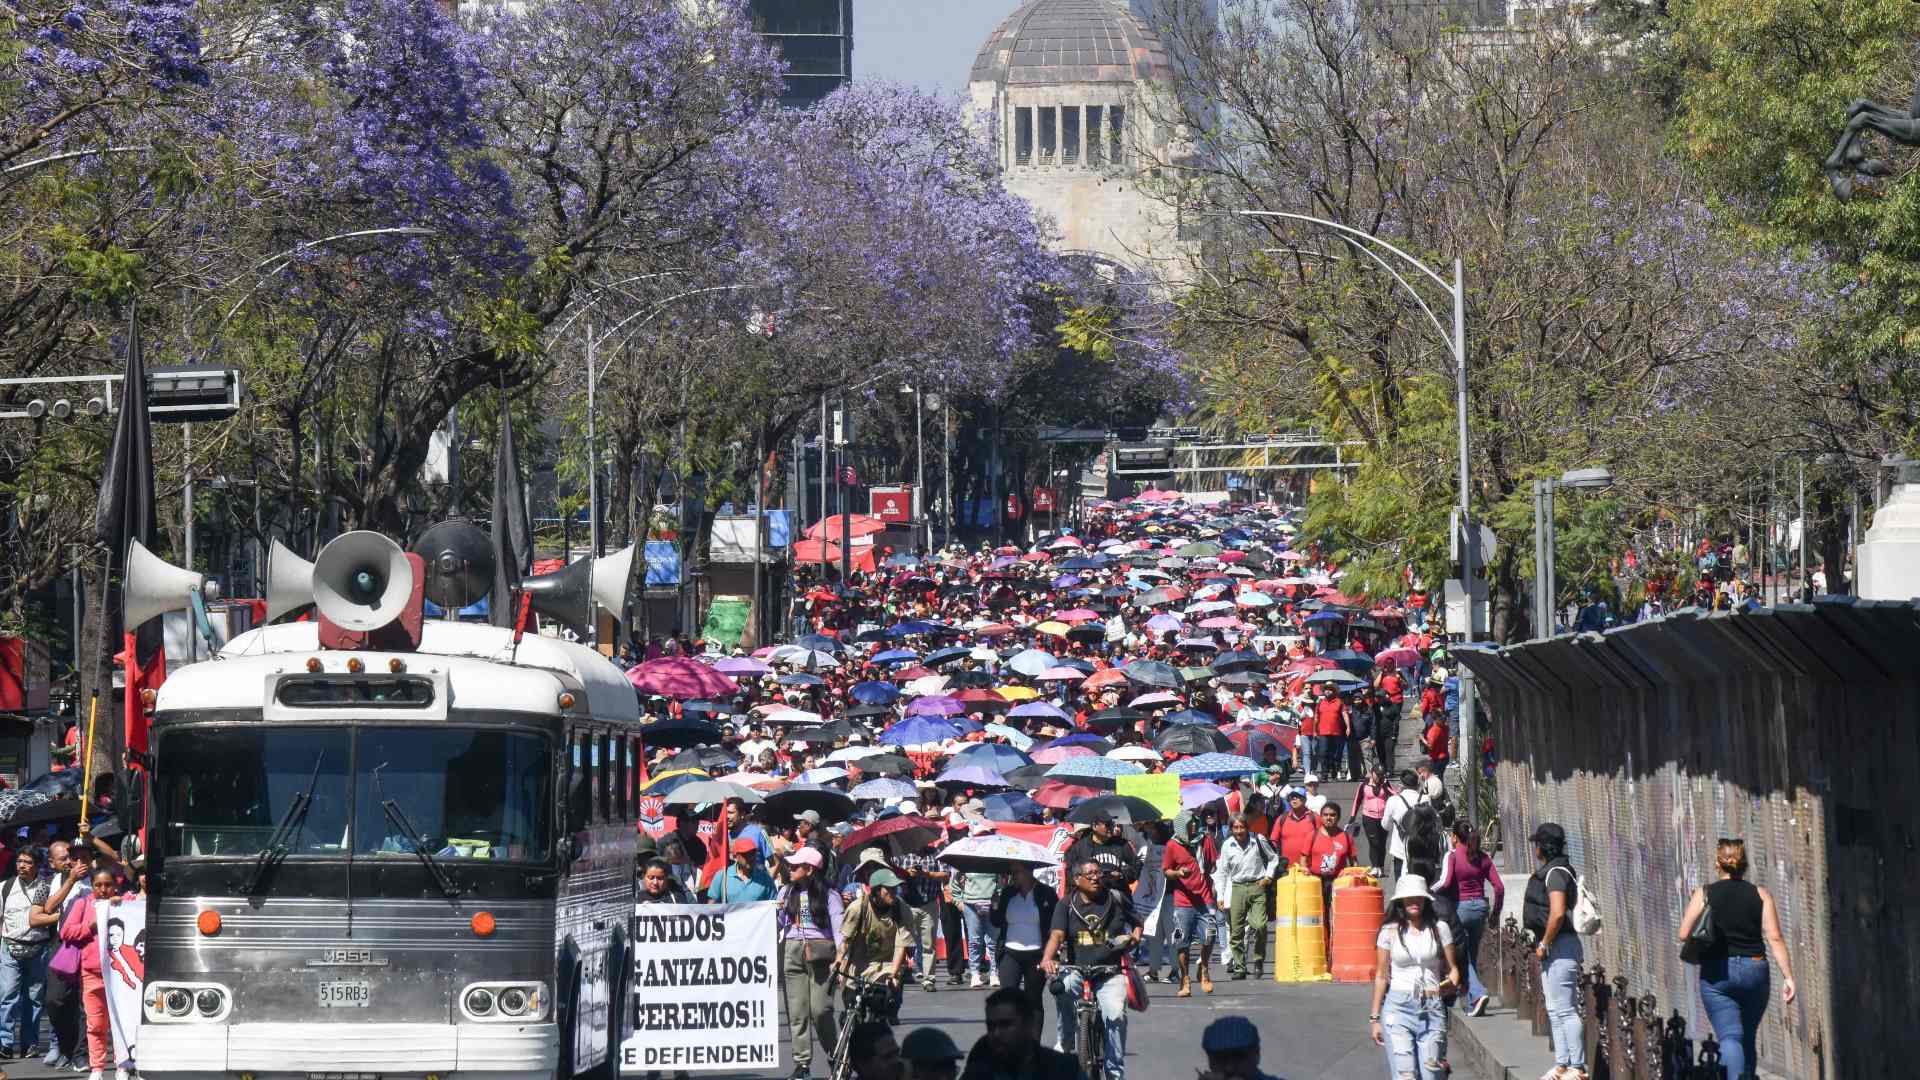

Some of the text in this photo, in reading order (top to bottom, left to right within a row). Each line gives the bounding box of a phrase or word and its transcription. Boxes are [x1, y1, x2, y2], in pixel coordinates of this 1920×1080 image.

[635, 914, 726, 942] UNIDOS
[323, 950, 370, 960] MASA
[320, 986, 368, 1000] 515RB3
[645, 1044, 774, 1064] DEFIENDEN!!
